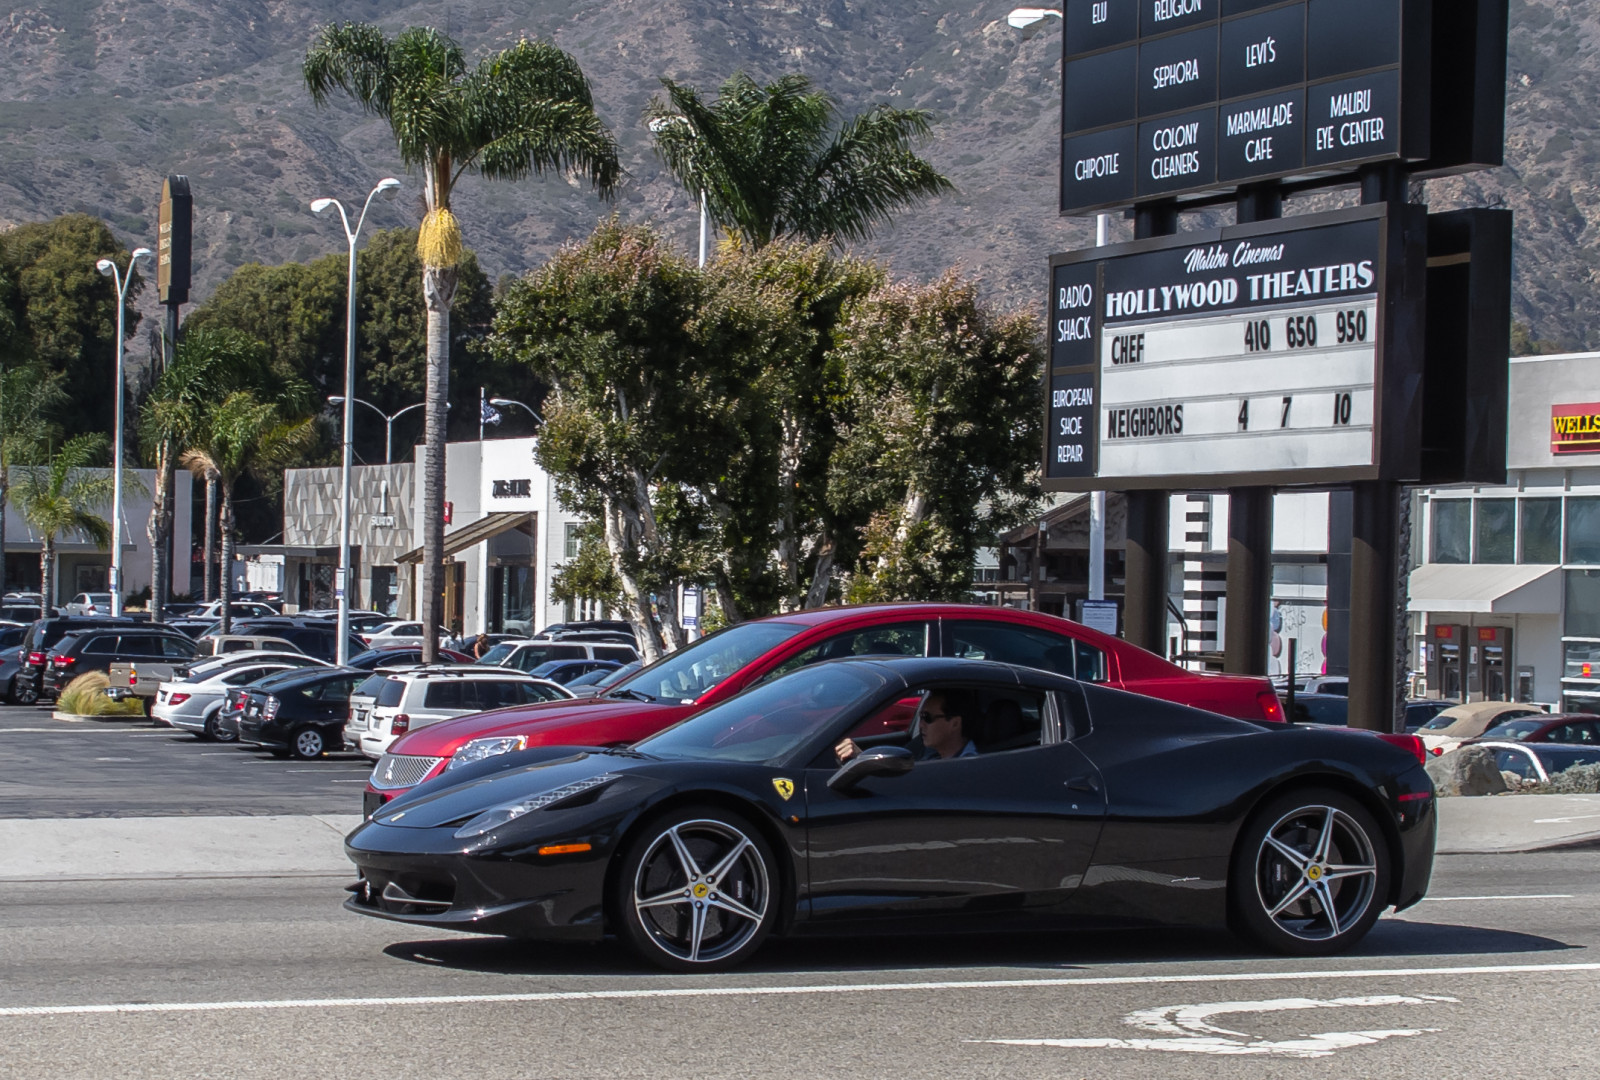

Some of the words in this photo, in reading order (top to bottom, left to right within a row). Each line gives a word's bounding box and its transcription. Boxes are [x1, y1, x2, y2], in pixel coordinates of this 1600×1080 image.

[1246, 36, 1276, 68] LEVI'S
[1153, 59, 1199, 90] SEPHORA
[1330, 89, 1372, 118] MALIBU
[1227, 102, 1294, 137] MARMALADE
[1316, 126, 1335, 151] EYE
[1340, 117, 1385, 147] CENTER
[1153, 122, 1200, 151] COLONY
[1245, 137, 1273, 163] CAFE
[1075, 153, 1120, 181] CHIPOTLE
[1151, 151, 1200, 180] CLEANERS
[1183, 244, 1229, 274] Malibu
[1232, 241, 1285, 268] Cinemas
[1059, 283, 1093, 310] RADIO
[1106, 278, 1239, 317] HOLLYWOOD
[1246, 260, 1375, 301] THEATERS
[1057, 316, 1092, 342] SHACK
[1111, 333, 1145, 365] CHEF
[1244, 319, 1271, 352] 410
[1286, 315, 1317, 349] 650
[1336, 309, 1367, 344] 950
[1052, 387, 1094, 408] EUROPEAN
[1060, 416, 1083, 436] SHOE
[1107, 404, 1184, 439] NEIGHBORS
[1237, 400, 1249, 430] 4
[1280, 397, 1292, 428] 7
[1333, 393, 1352, 425] 10
[1552, 414, 1600, 434] WELLS
[1057, 444, 1084, 463] REPAIR
